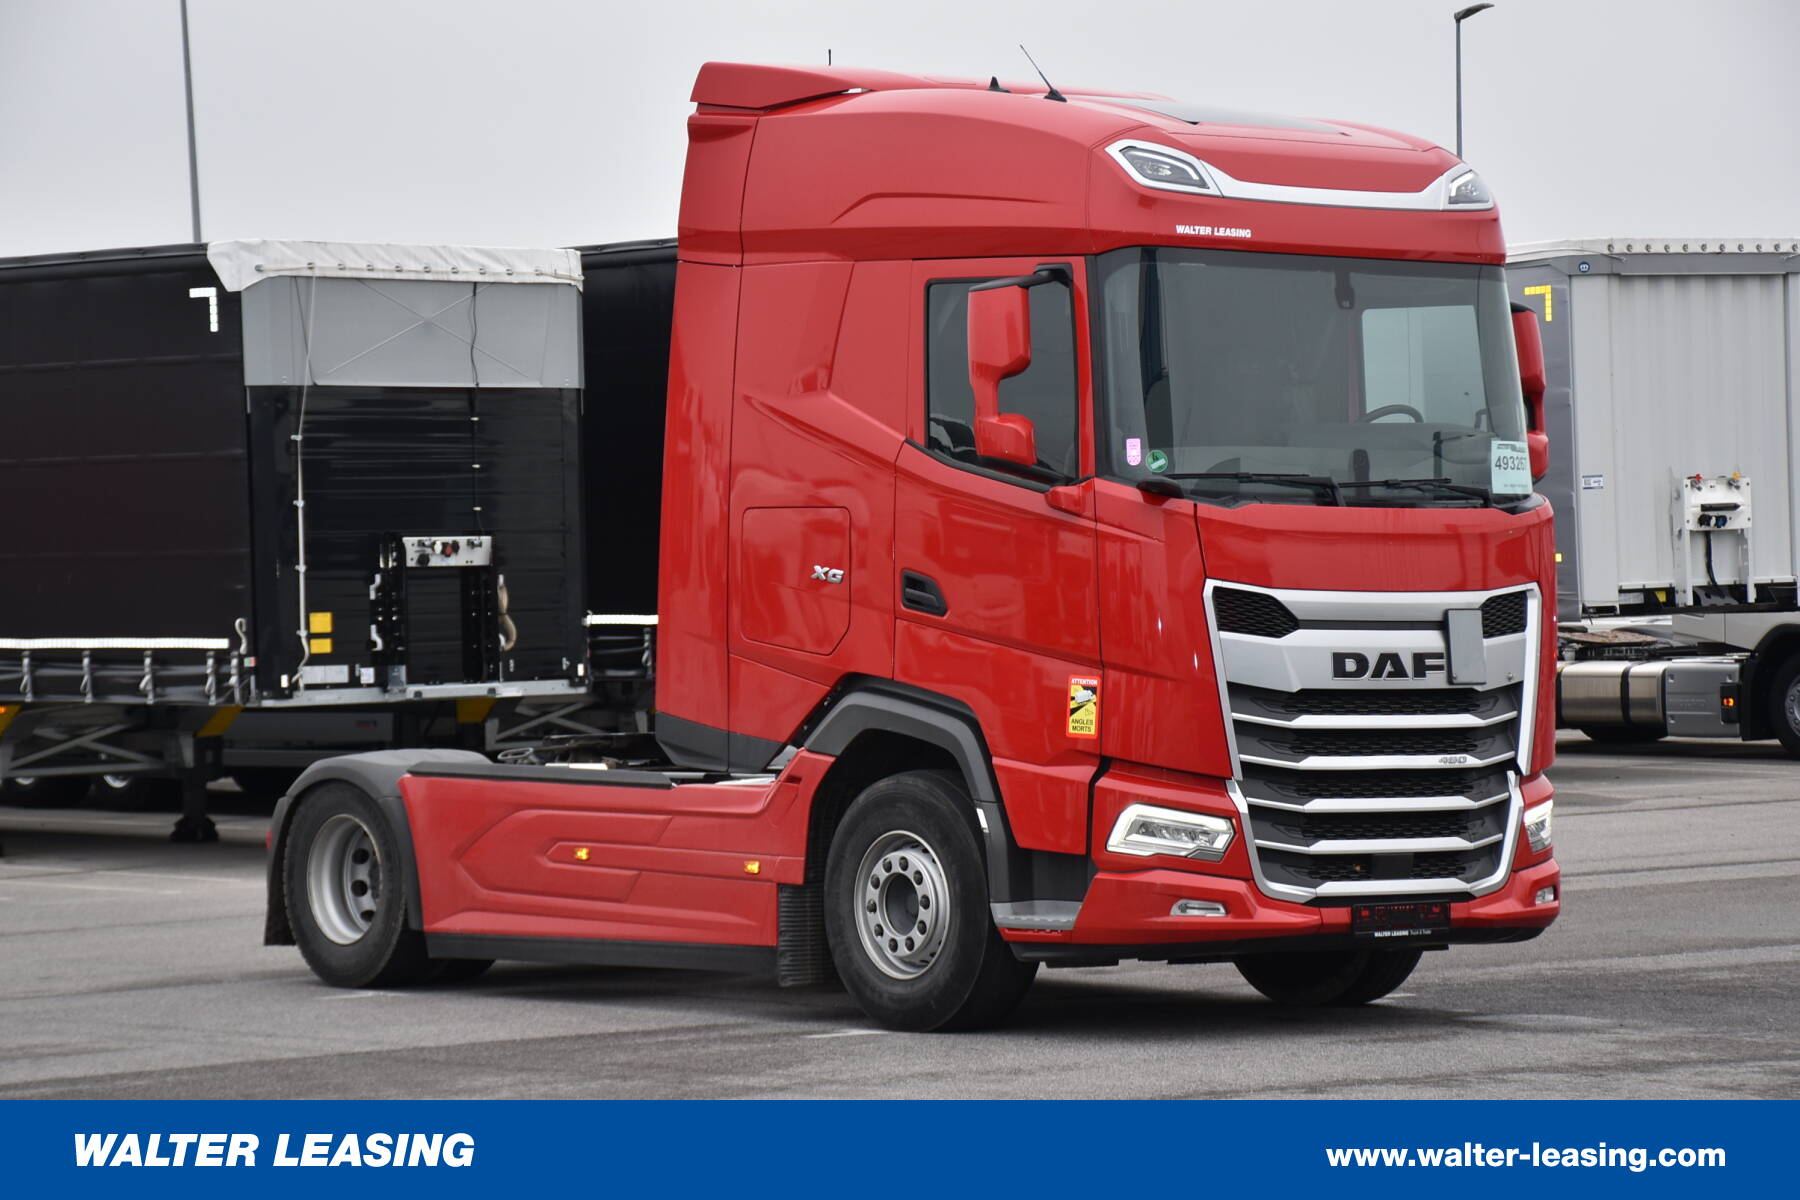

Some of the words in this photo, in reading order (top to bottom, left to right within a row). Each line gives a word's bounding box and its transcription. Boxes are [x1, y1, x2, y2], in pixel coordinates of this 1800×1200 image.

[1176, 225, 1211, 235] WALTER
[1214, 227, 1252, 238] LEASING
[810, 565, 845, 584] XG
[1332, 652, 1445, 680] DAF
[1071, 718, 1094, 726] ANGLES
[1071, 725, 1092, 733] MORTS
